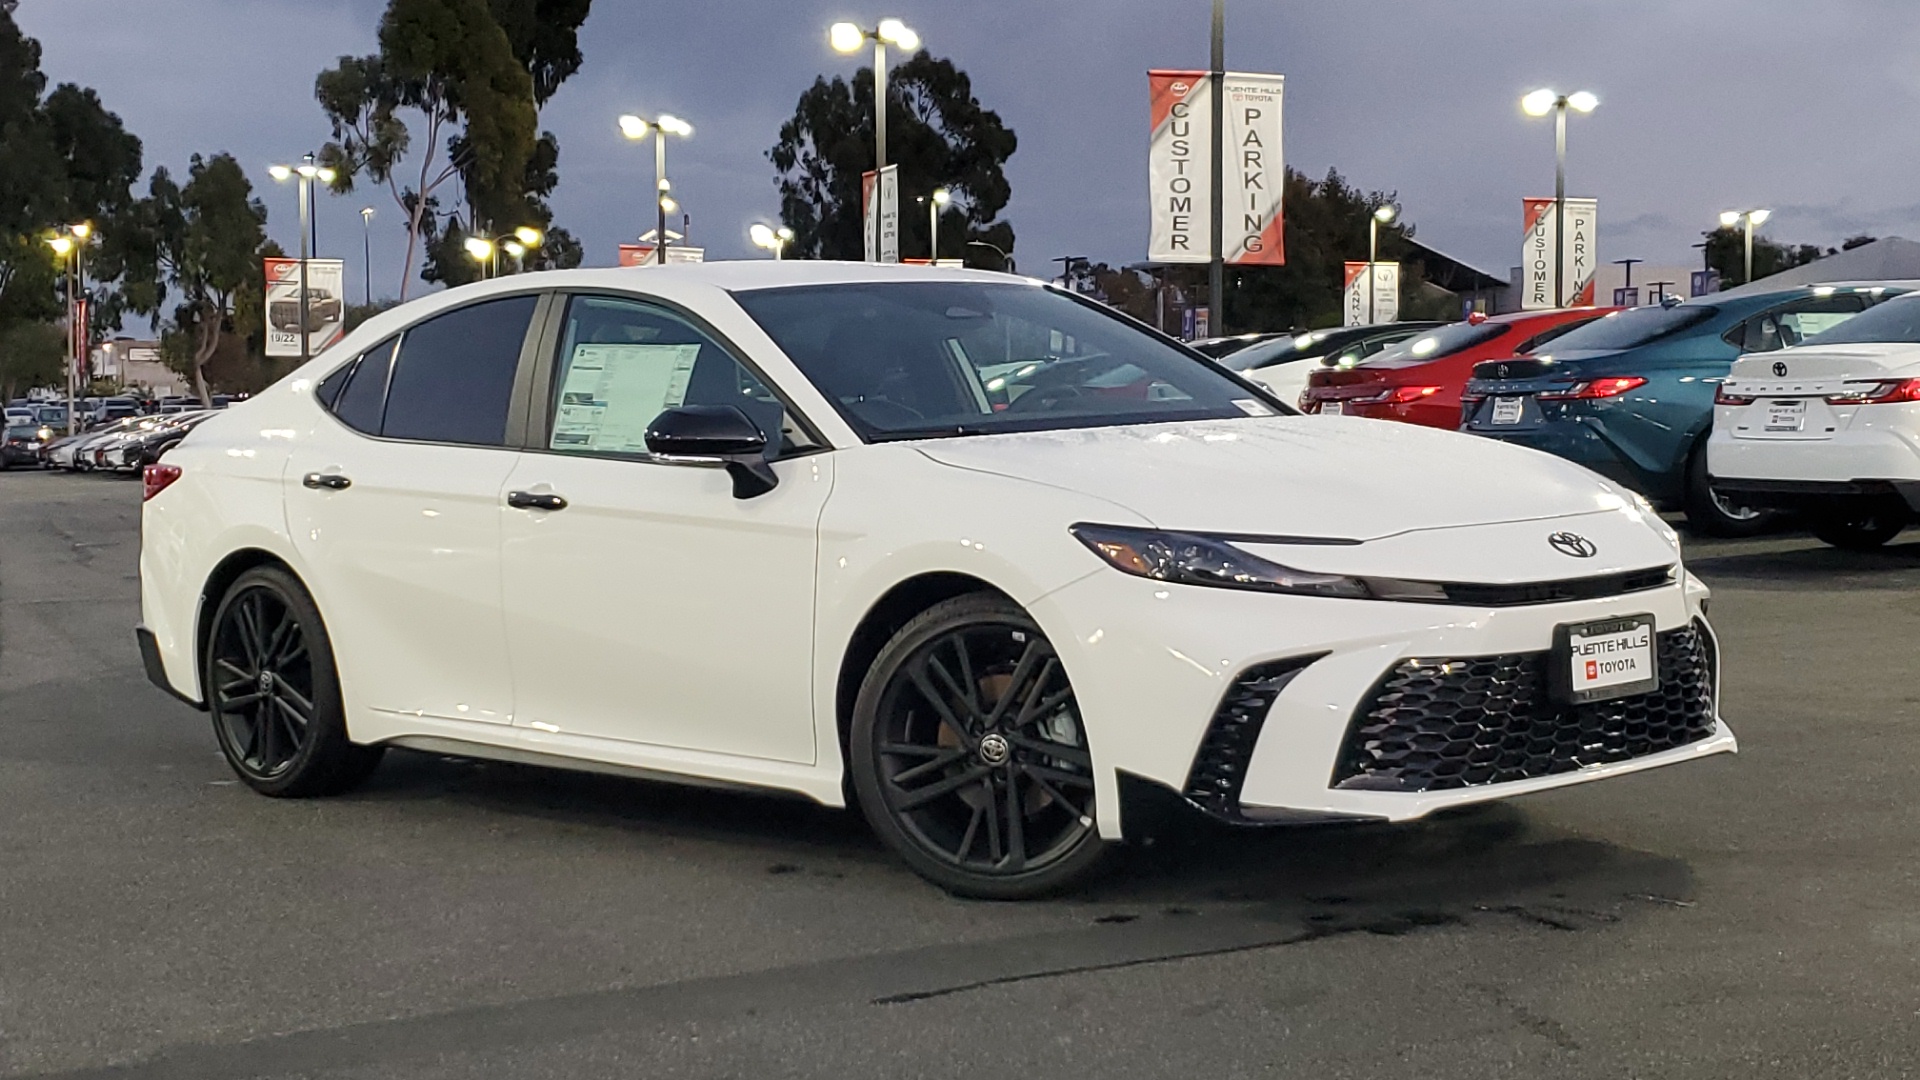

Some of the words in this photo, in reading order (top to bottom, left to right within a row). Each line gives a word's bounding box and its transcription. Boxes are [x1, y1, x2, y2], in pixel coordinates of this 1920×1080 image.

[1245, 94, 1273, 102] TOYOTA
[1169, 102, 1192, 251] CUSTOMER
[1242, 108, 1264, 252] PARKING
[1533, 217, 1546, 303] CUSTOMER
[1572, 218, 1585, 303] PARKING
[1570, 640, 1615, 656] PUENTE
[1616, 635, 1649, 651] HILLS
[1599, 658, 1636, 674] TOYOTA
